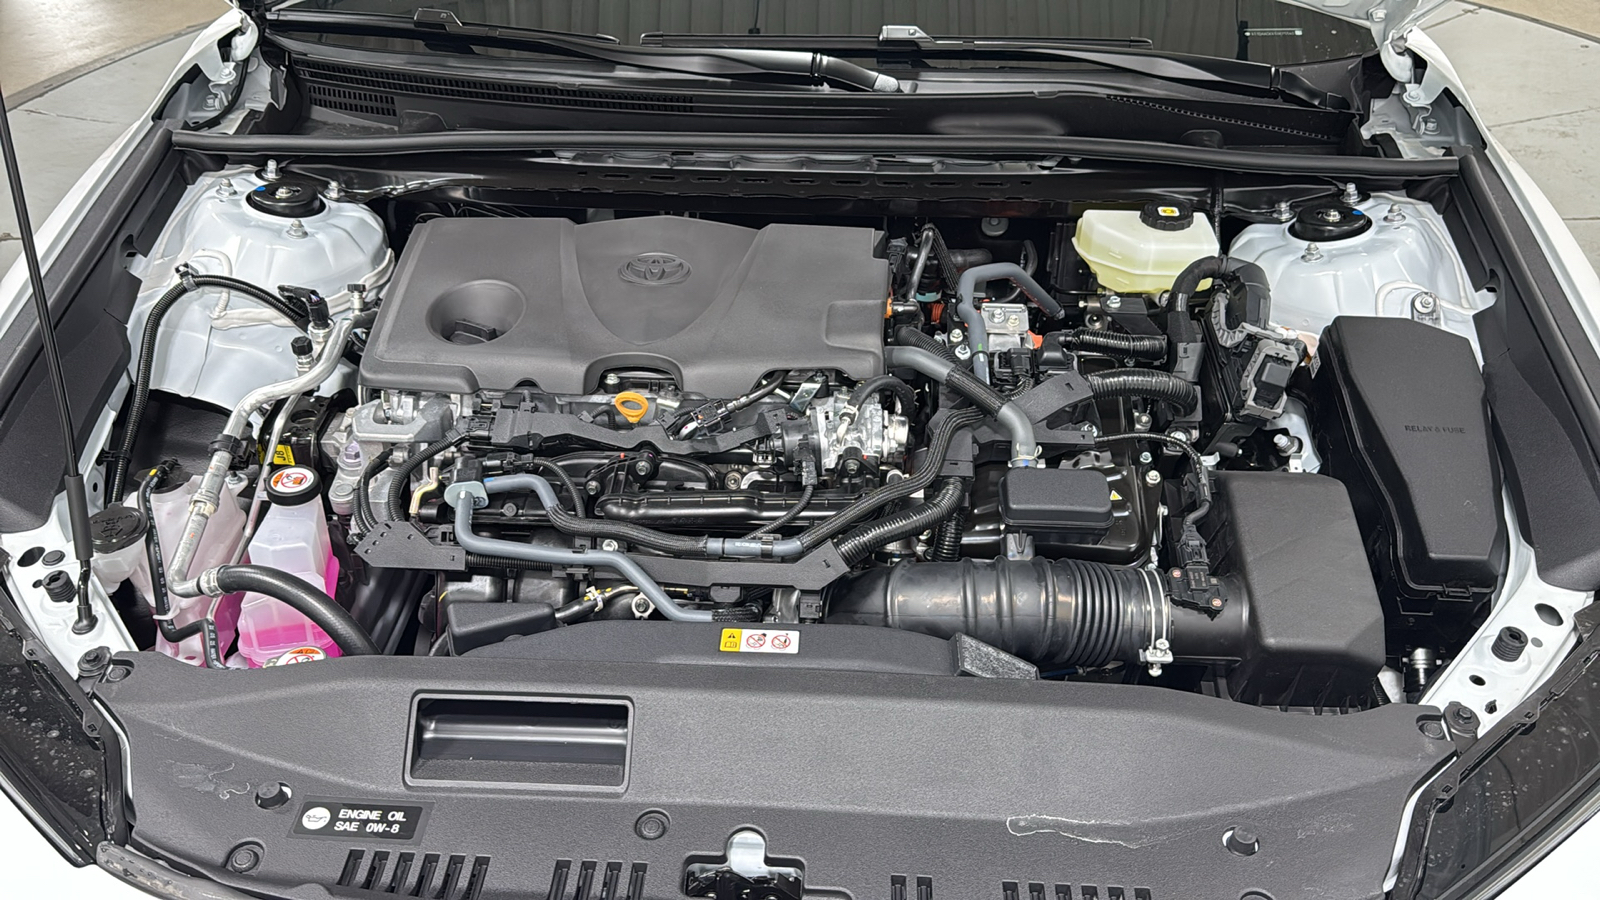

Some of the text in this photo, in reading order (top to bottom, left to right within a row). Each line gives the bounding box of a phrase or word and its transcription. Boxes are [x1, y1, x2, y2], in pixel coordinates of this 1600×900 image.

[1404, 425, 1433, 433] RELAY
[1442, 426, 1466, 434] FUSE
[338, 808, 407, 821] ENGINE OIL
[333, 821, 400, 834] SAE 0W-8
